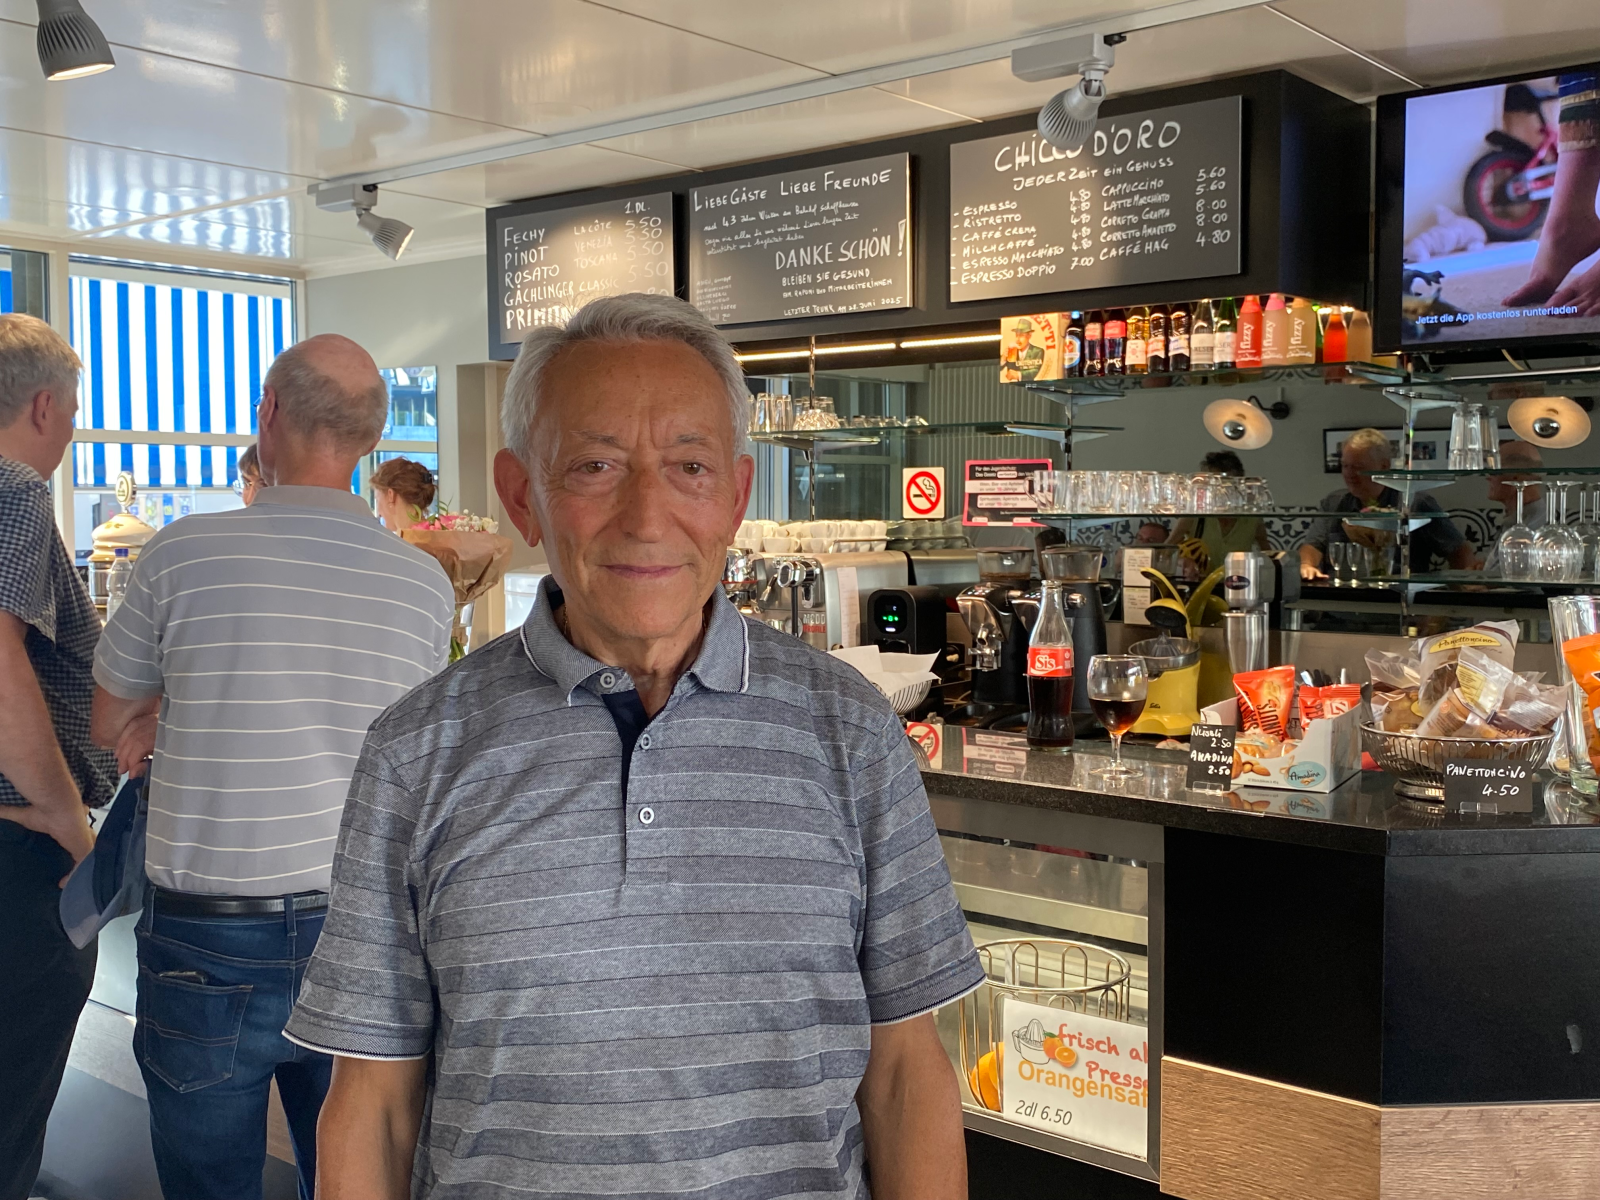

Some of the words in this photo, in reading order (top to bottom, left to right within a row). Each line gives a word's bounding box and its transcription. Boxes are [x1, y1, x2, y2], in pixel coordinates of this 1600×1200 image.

[1093, 120, 1181, 156] D'ORO
[1126, 157, 1174, 172] GENUSS
[694, 190, 728, 212] LIEBE
[780, 181, 816, 196] LIEBE
[824, 169, 892, 191] FREUNDE
[1101, 178, 1164, 196] CAPPUCCINO
[1196, 167, 1226, 182] 5.60
[1195, 180, 1226, 195] 5.60
[962, 200, 1018, 216] ESPRESSO
[1196, 199, 1227, 212] 8.00
[722, 215, 737, 227] 43
[963, 213, 1021, 228] RISTRETTO
[1196, 213, 1228, 226] 8.00
[504, 227, 545, 247] FECHY
[624, 216, 662, 232] 5.50
[1004, 226, 1036, 236] CREMA
[1144, 239, 1169, 254] HAG
[1196, 229, 1231, 247] 4.80
[504, 246, 549, 270] PINOT
[775, 242, 834, 270] DANKE
[505, 264, 560, 288] ROSATO
[574, 252, 618, 269] TOSCANA
[782, 273, 812, 286] BLEIBEN
[816, 271, 830, 283] SIE
[832, 268, 870, 281] GESUND
[961, 269, 1014, 284] ESPRESSO
[1017, 262, 1056, 278] DOPPIO
[1070, 256, 1094, 270] 7.00
[579, 276, 620, 292] CLASSIC
[783, 305, 810, 316] LETZTER
[812, 304, 835, 314] TRUNK
[837, 305, 847, 313] AM
[881, 296, 903, 305] 2025
[1415, 316, 1438, 325] Jetzt
[1440, 314, 1453, 323] die
[1456, 312, 1474, 325] App
[1476, 308, 1520, 320] kostenlos
[1522, 305, 1578, 317] runterladen
[1240, 322, 1254, 349] fizzy
[1263, 320, 1276, 346] fizzy
[1291, 317, 1305, 344] fizzy
[1210, 737, 1232, 748] 2.50
[1207, 765, 1231, 775] 2.50
[1446, 764, 1526, 780] PANETTONCINO
[1482, 784, 1520, 797] 4.50
[1057, 1023, 1120, 1056] frisch
[1015, 1099, 1037, 1118] 2dl
[1040, 1106, 1073, 1126] 6.50
